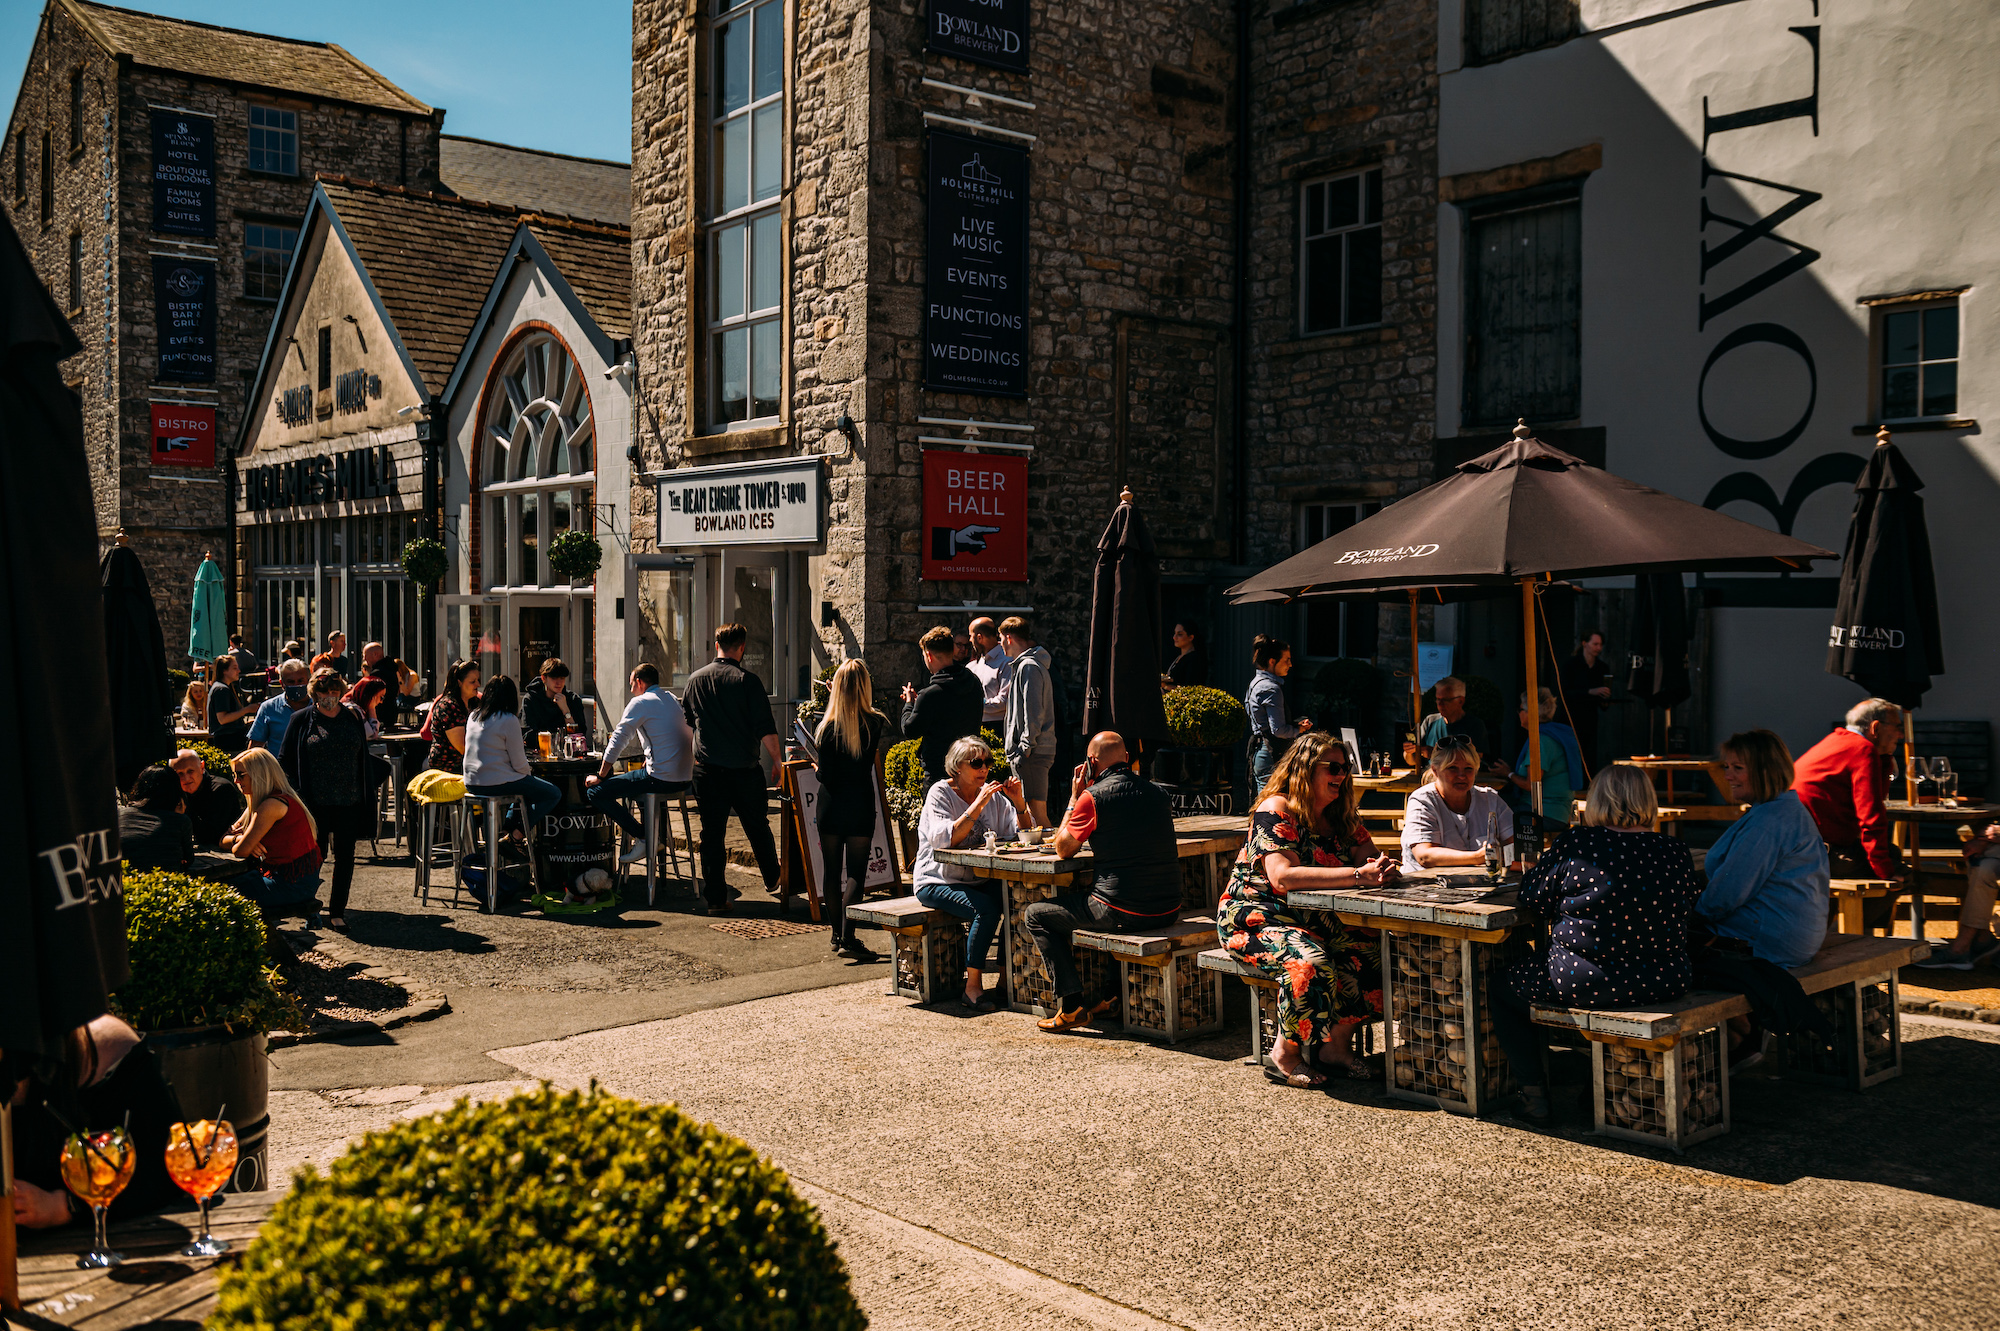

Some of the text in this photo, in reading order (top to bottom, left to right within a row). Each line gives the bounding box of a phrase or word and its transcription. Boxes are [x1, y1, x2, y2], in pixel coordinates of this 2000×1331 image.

[936, 11, 1021, 54] BOWLAND
[954, 33, 1000, 54] BREWERY
[167, 150, 199, 161] HOTEL
[155, 171, 212, 186] BEDROOMS
[158, 164, 208, 177] BOUTIQUE
[167, 187, 201, 198] FAMILY
[941, 177, 1015, 200] HOLMES MILL
[166, 196, 202, 207] ROOMS
[958, 191, 1000, 205] CLITHEROE
[167, 211, 201, 223] SUITES
[961, 216, 995, 236] LIVE
[952, 232, 1003, 254] MUSIC
[947, 267, 1008, 290] EVENTS
[168, 302, 204, 310] BISTRO
[172, 311, 193, 319] BAR
[930, 303, 1022, 330] FUNCTIONS
[169, 336, 204, 345] EVENTS
[162, 353, 213, 363] FUNCTIONS
[931, 342, 1020, 367] WEDDINGS
[942, 373, 1009, 386] HOLMESMILL.CO.UK
[158, 417, 208, 431] BISTRO
[246, 445, 397, 511] HOLMES MILL
[947, 468, 1006, 491] BEER
[683, 487, 707, 514] BEAM
[709, 484, 742, 512] ENGINE
[744, 481, 780, 510] TOWER
[948, 494, 1006, 516] HALL
[695, 512, 774, 532] BOWLAND ICES
[1333, 543, 1440, 565] BOWLAND
[1351, 554, 1408, 565] BREWERY
